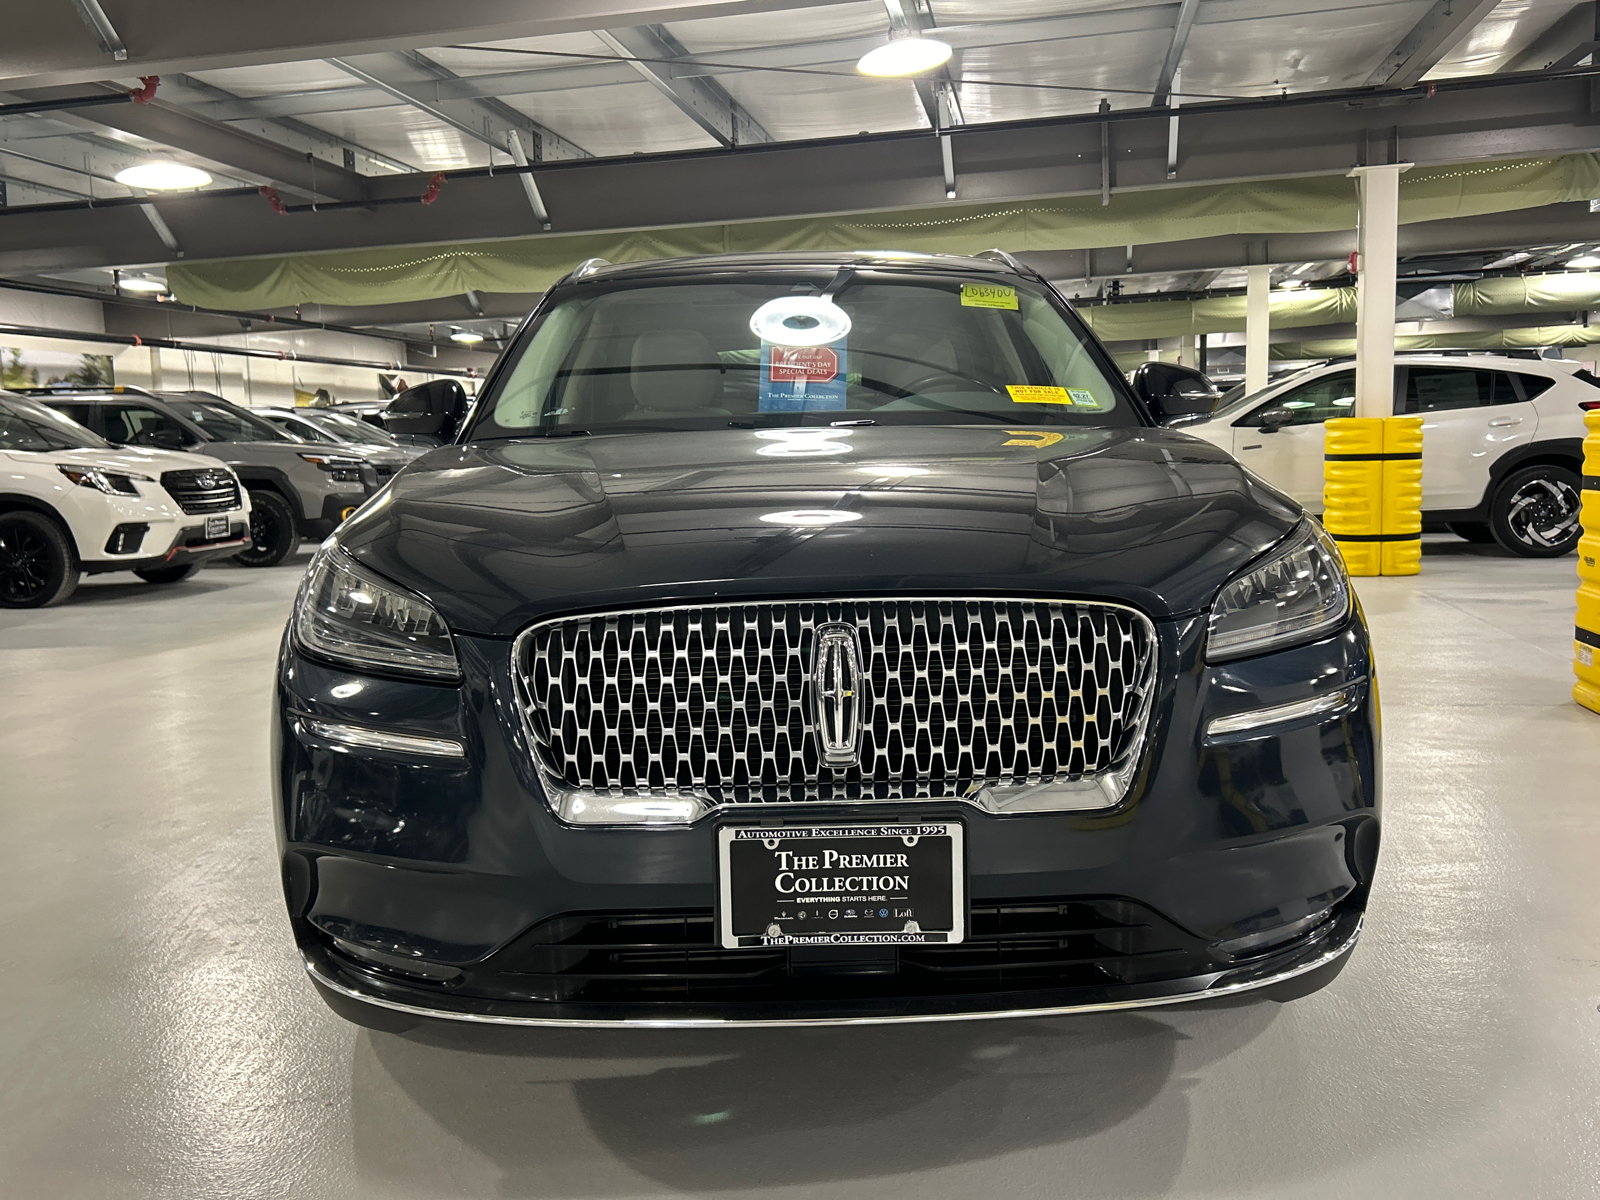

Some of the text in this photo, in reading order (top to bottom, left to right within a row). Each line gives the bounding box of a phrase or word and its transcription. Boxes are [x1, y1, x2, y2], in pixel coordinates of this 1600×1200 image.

[738, 826, 945, 838] AUTOMOTIVE EXCELLENCE SINCE 1995
[774, 849, 909, 870] THE PREMIER
[774, 872, 909, 893] COLLECTION
[894, 908, 913, 918] Loft
